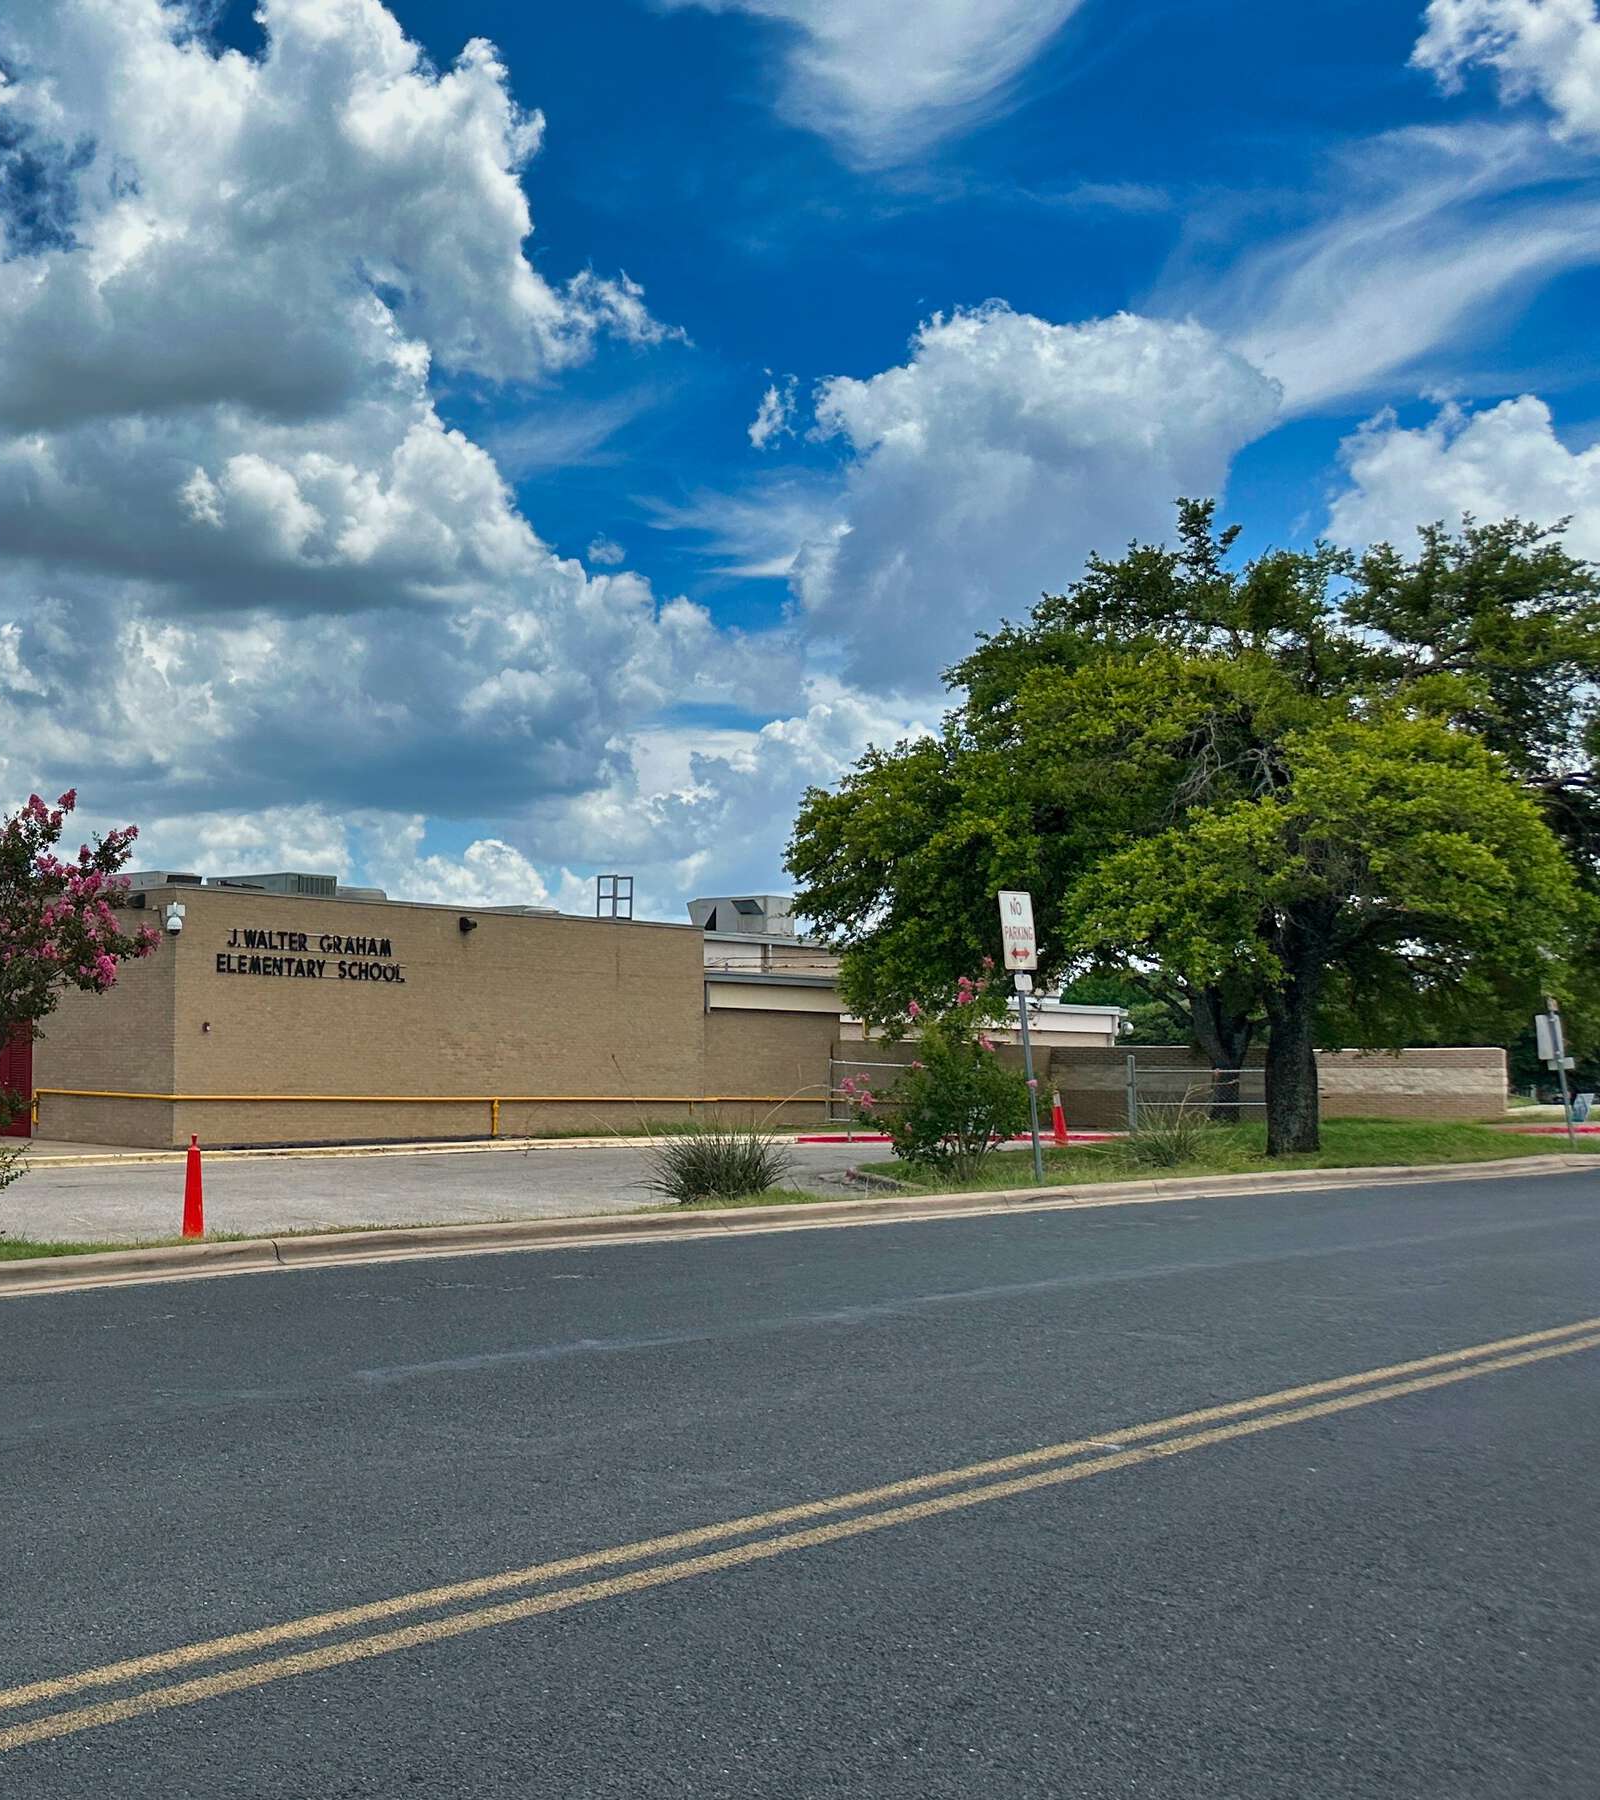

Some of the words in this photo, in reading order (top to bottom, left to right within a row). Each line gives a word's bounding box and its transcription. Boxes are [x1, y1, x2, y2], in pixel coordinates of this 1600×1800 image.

[1009, 901, 1022, 915] NO
[1004, 926, 1033, 940] PARKING
[320, 934, 392, 957] GRAHAM
[216, 953, 326, 978] ELEMENTARY
[338, 960, 405, 982] SCHOOL
